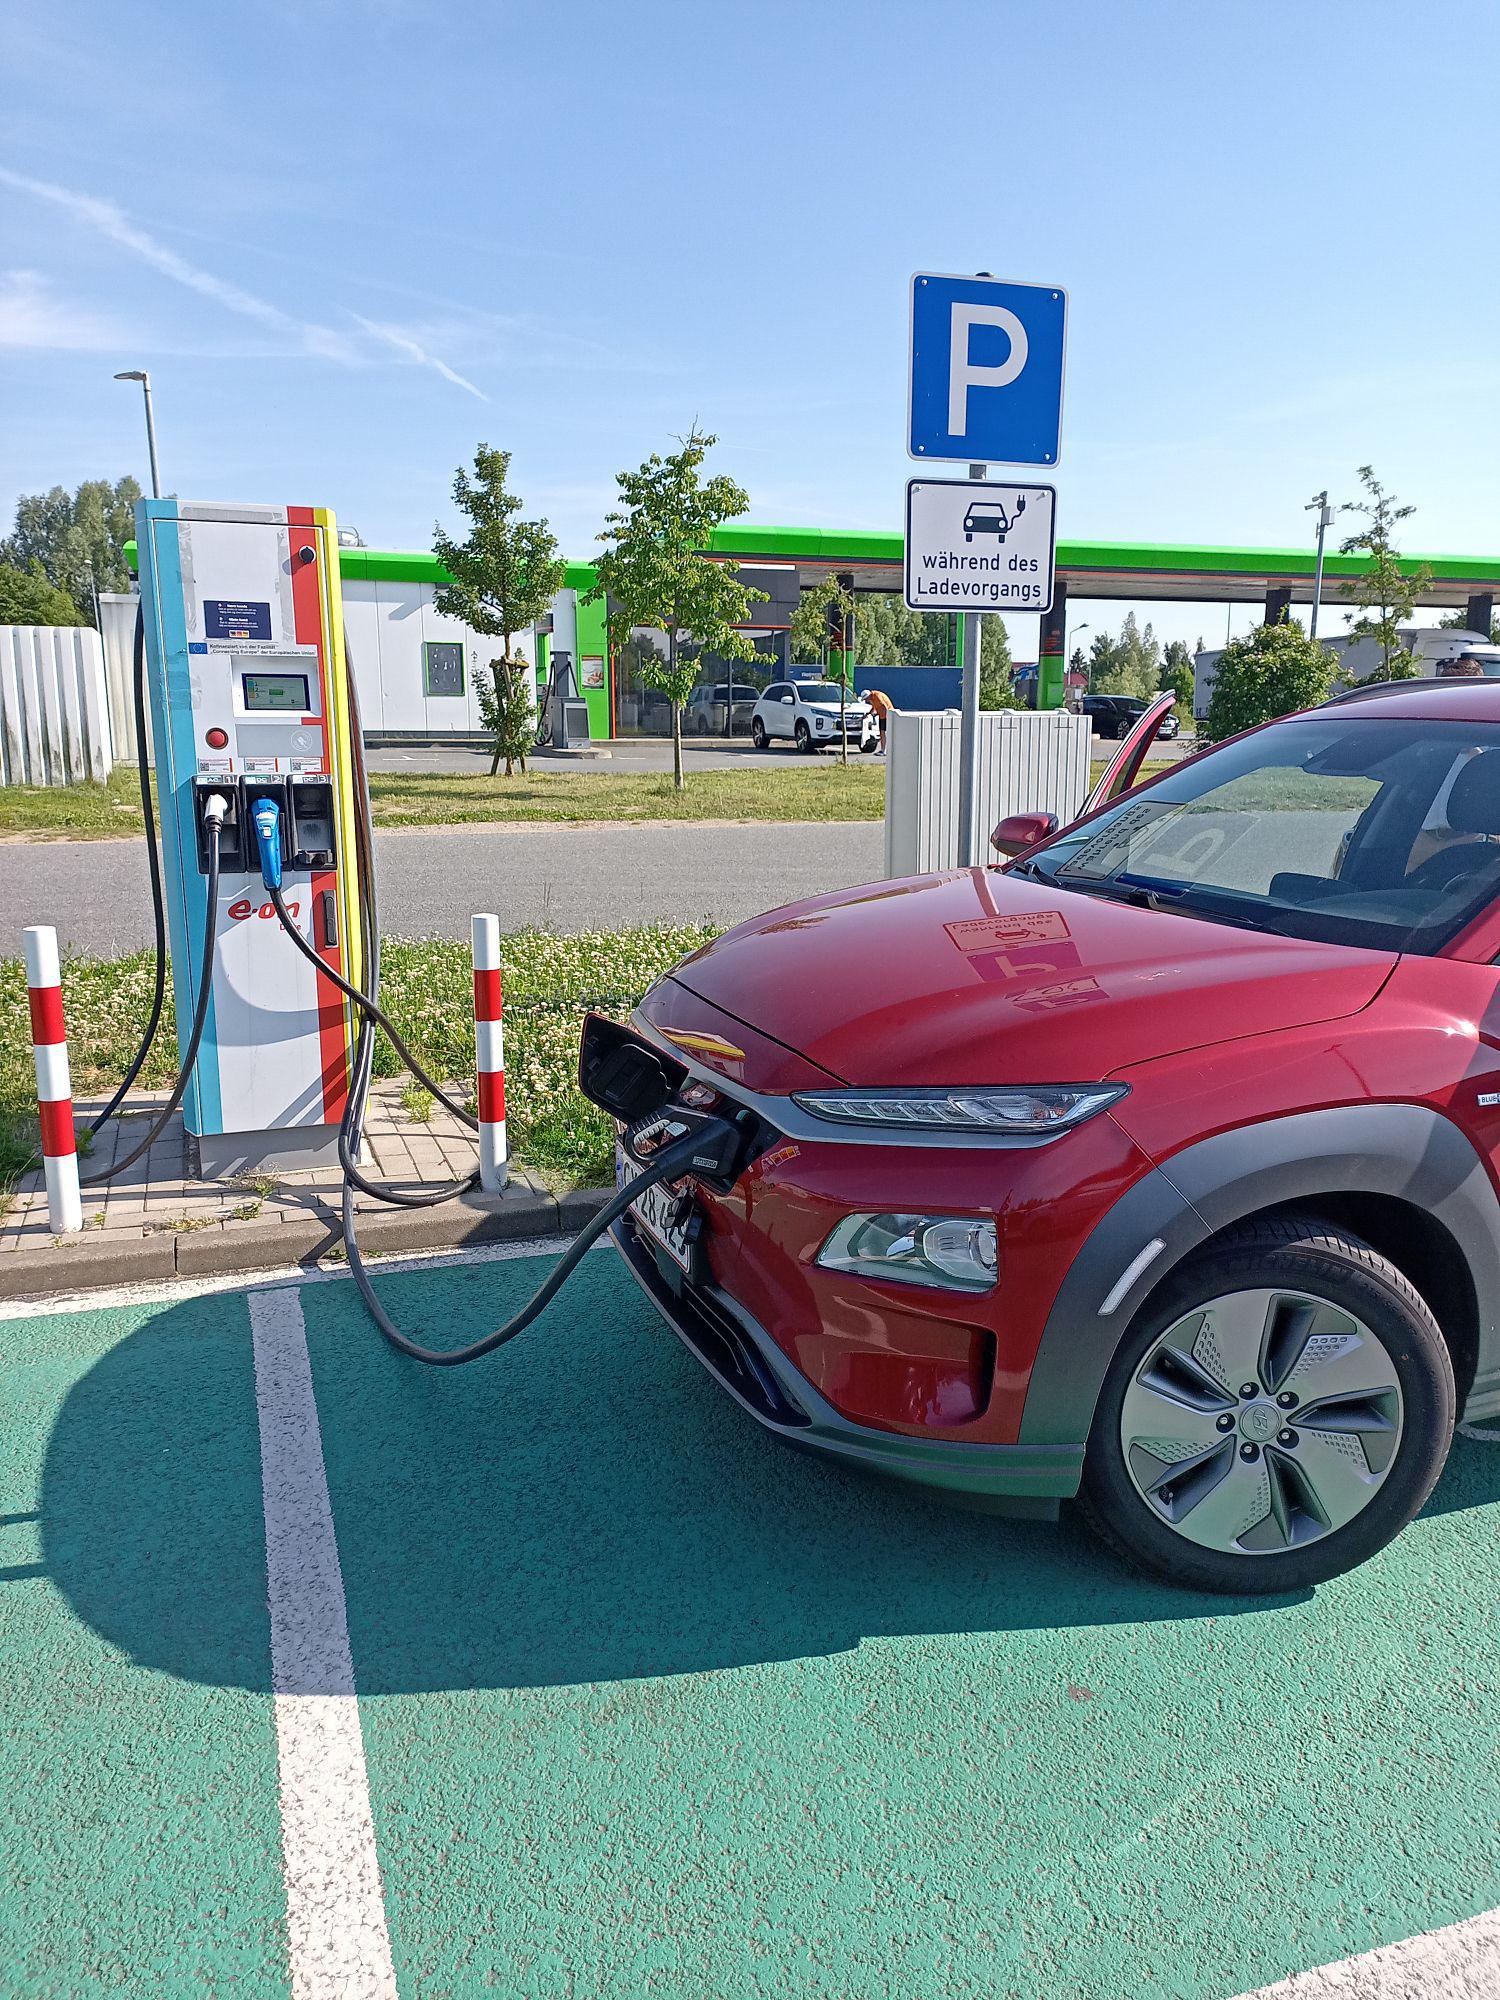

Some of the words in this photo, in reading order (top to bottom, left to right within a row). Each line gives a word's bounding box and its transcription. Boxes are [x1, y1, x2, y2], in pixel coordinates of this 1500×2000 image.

[947, 301, 1029, 436] P
[922, 551, 1000, 571] während
[1008, 553, 1039, 572] des
[917, 576, 1042, 602] Ladevorgangs
